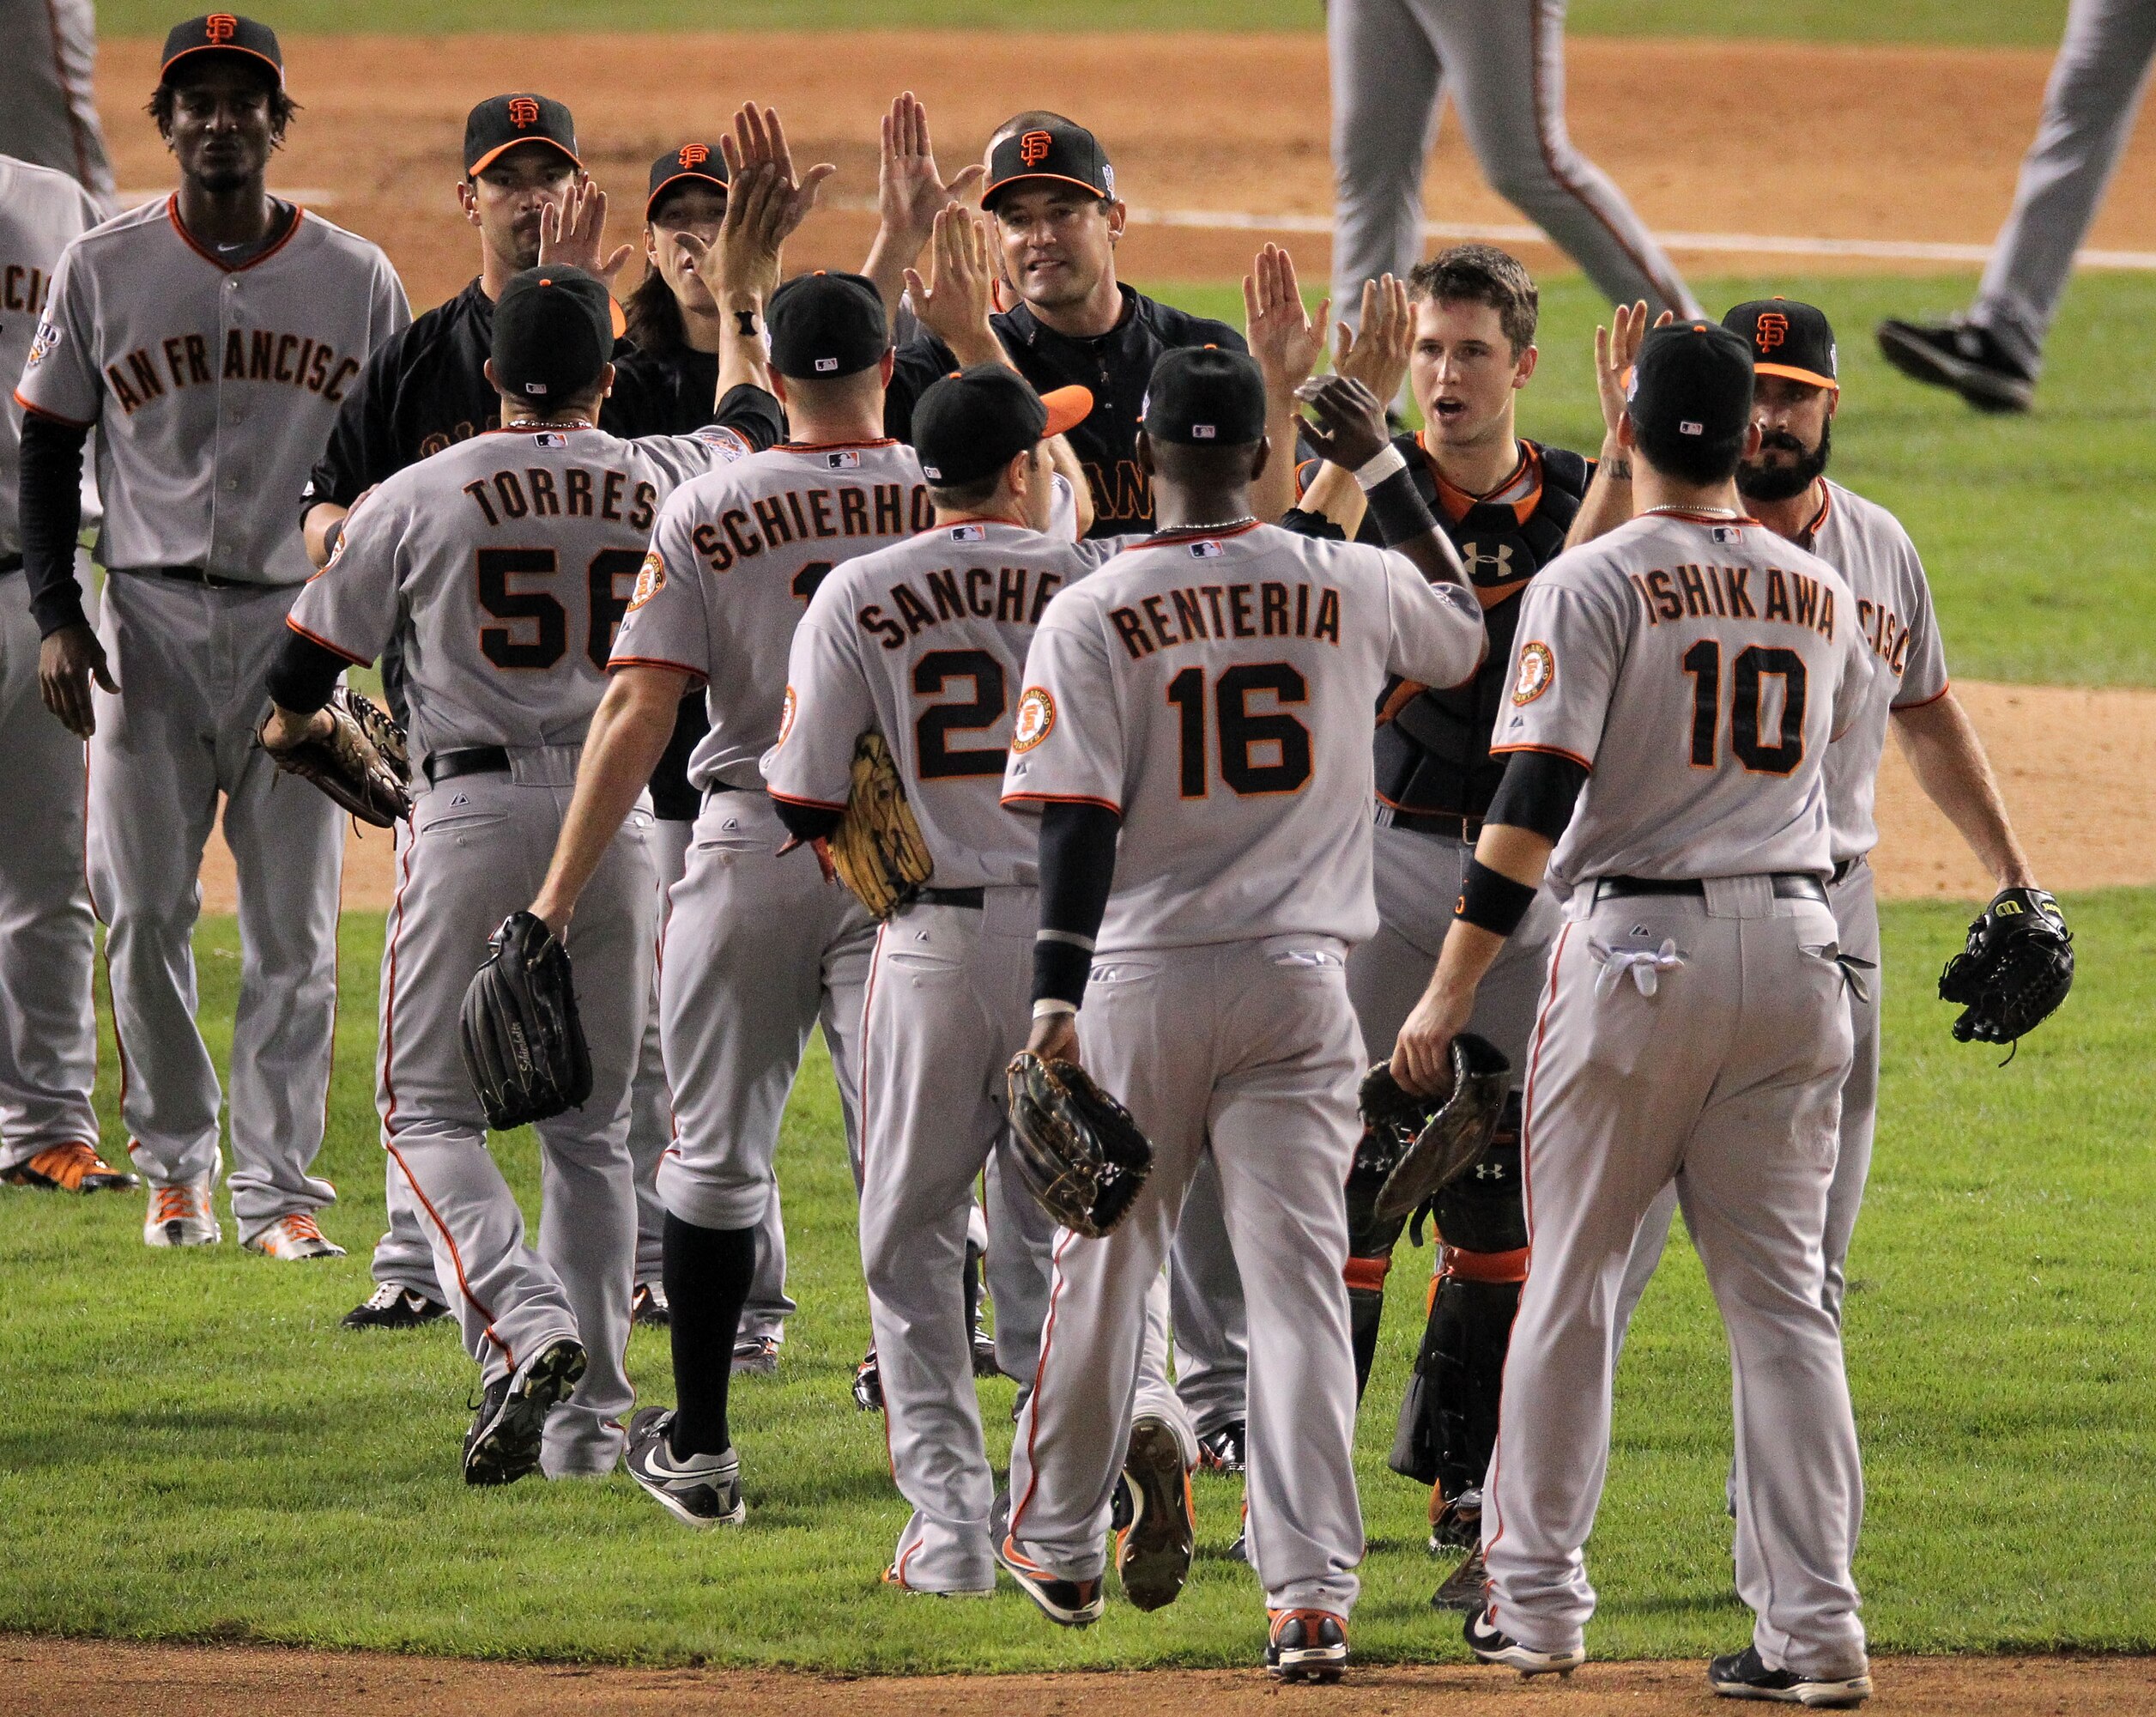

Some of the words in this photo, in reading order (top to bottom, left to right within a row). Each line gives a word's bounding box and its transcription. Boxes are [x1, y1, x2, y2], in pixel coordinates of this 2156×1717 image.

[207, 13, 237, 45] SF
[508, 97, 539, 129] SF
[679, 143, 710, 169] SF
[1021, 130, 1051, 167] SF
[3, 264, 51, 314] CI
[1756, 312, 1789, 353] SF
[463, 466, 659, 531] TORRES
[691, 482, 936, 573] SCHIERHO
[1109, 580, 1342, 661] RENTERIA
[1629, 562, 1836, 646] ISHIKAWA
[1165, 660, 1316, 802] 16
[1681, 637, 1809, 777] 10
